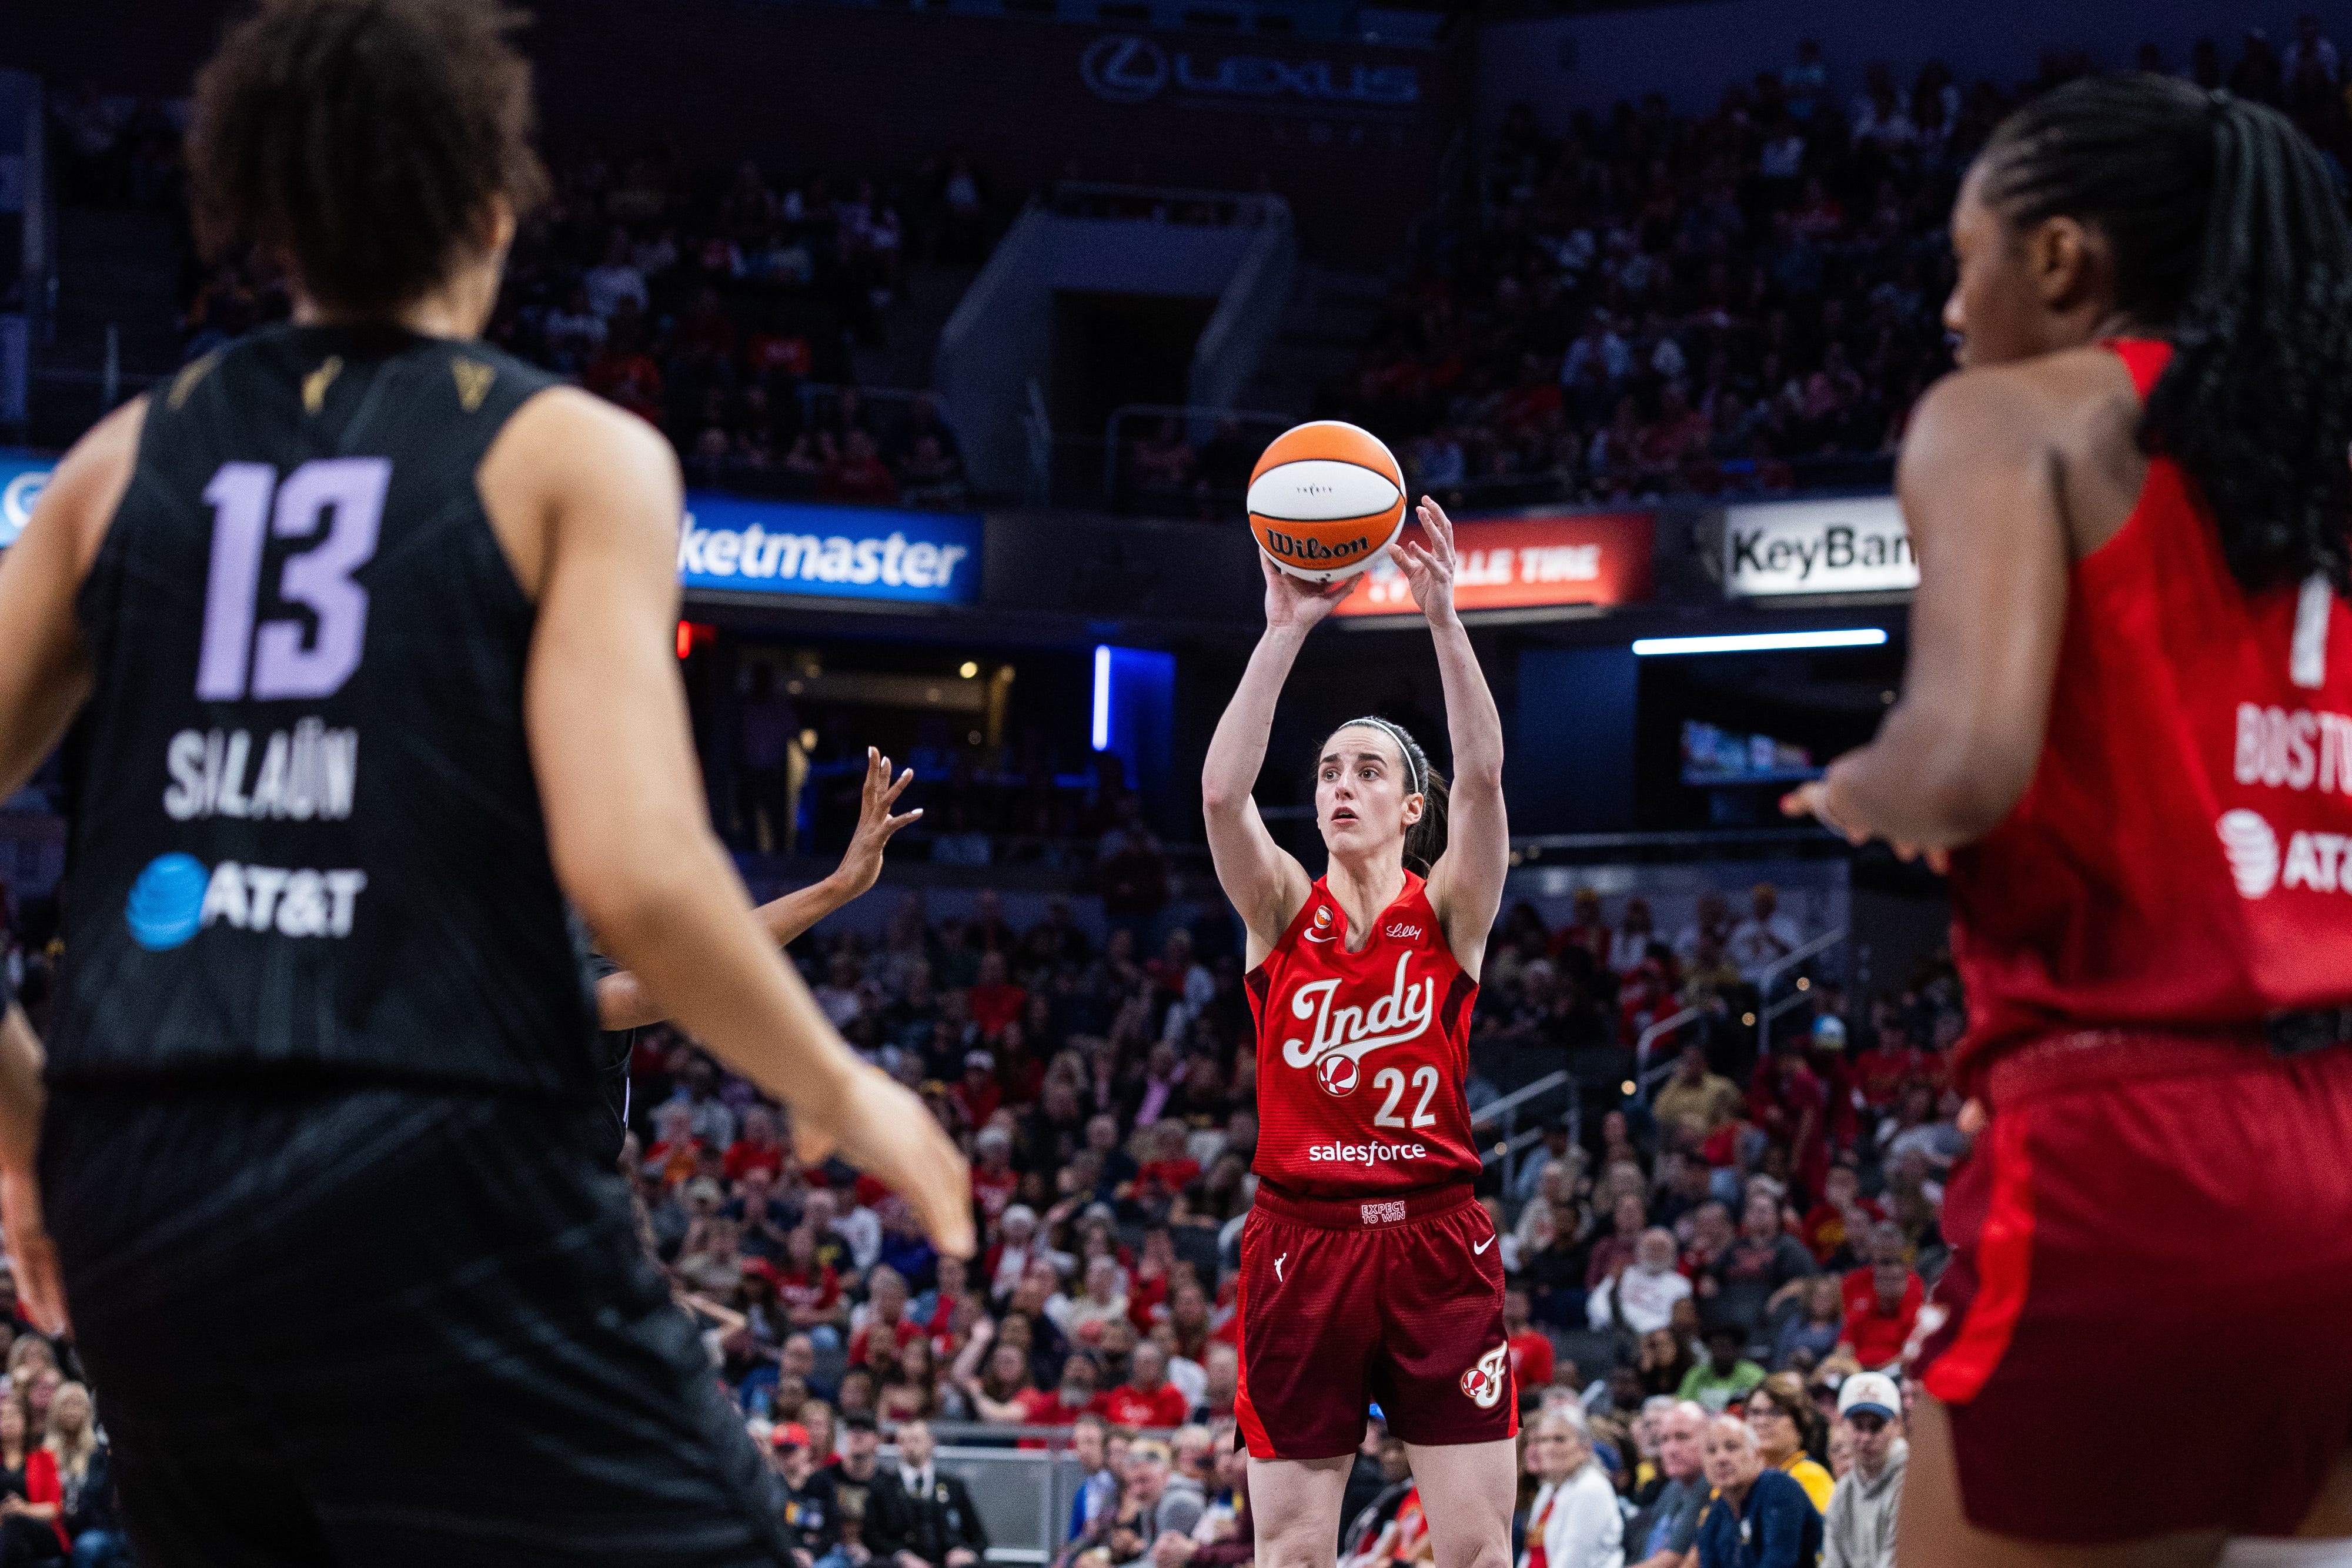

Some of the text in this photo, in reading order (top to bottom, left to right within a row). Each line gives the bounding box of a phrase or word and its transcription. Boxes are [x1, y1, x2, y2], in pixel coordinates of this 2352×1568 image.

[677, 509, 969, 589] ketmaster
[1266, 527, 1369, 559] Wilson
[1731, 524, 1919, 581] KeyBan
[195, 455, 393, 702] 13
[199, 860, 368, 939] AT&T
[1386, 922, 1422, 940] Lilly
[1282, 950, 1435, 1069] Indy
[1373, 1065, 1439, 1128] 22
[1309, 1141, 1426, 1166] salesforce
[1361, 1201, 1405, 1215] EXPECT
[1362, 1211, 1405, 1224] TO WIN
